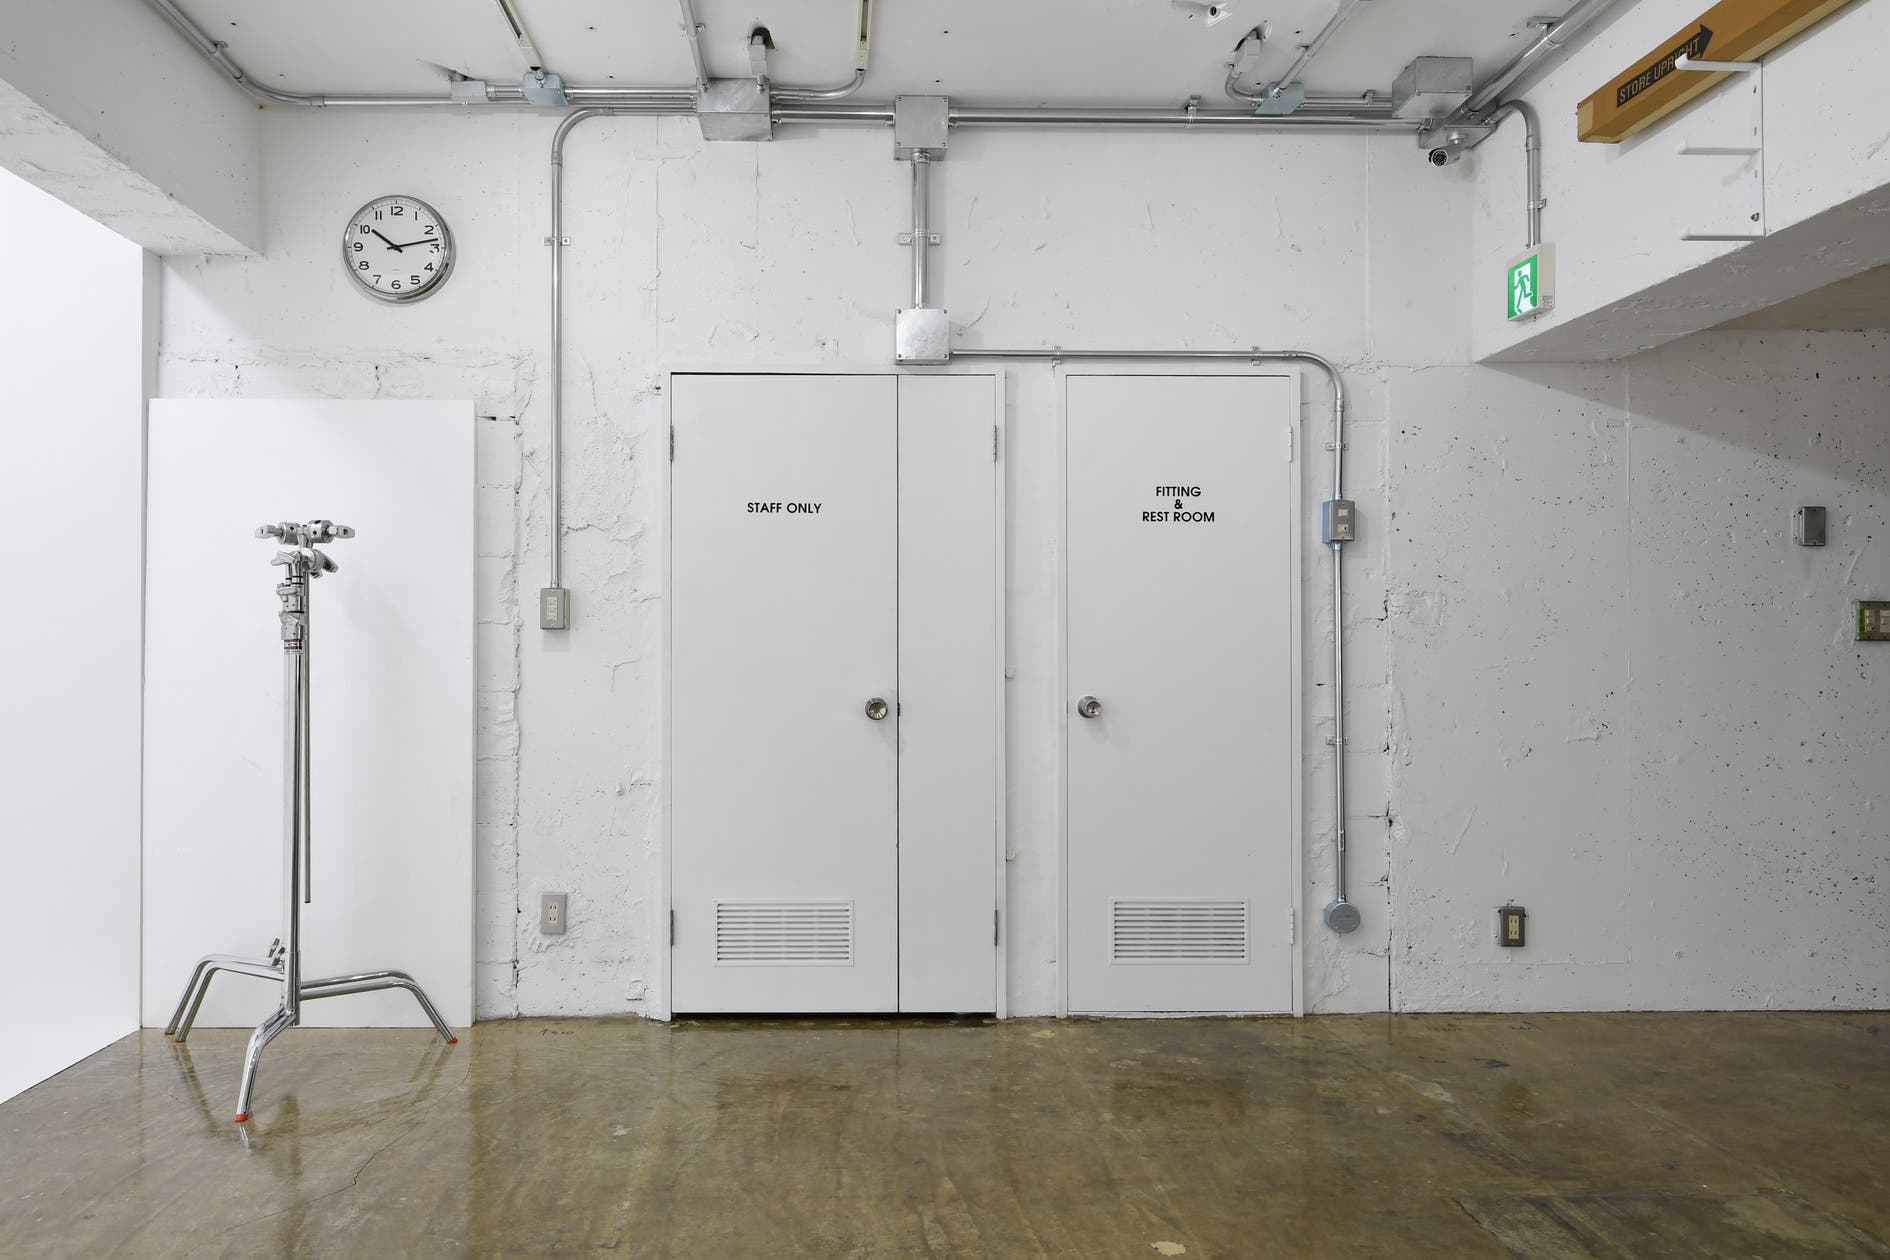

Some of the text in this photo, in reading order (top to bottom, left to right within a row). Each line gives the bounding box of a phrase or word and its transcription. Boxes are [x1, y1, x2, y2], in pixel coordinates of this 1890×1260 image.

[1620, 71, 1652, 102] STORE
[375, 210, 383, 220] 11
[390, 206, 404, 216] 12
[414, 211, 418, 221] 1
[360, 224, 371, 234] 10
[424, 225, 434, 235] 2
[353, 242, 364, 252] 9
[429, 243, 440, 254] 3
[358, 260, 370, 270] 8
[424, 262, 434, 272] 4
[372, 274, 382, 284] 7
[410, 275, 421, 285] 5
[391, 280, 401, 290] 6
[1156, 486, 1201, 497] FITTING
[747, 502, 822, 514] STAFF ONLY
[1174, 499, 1183, 509] &
[1142, 511, 1215, 522] REST ROOM
